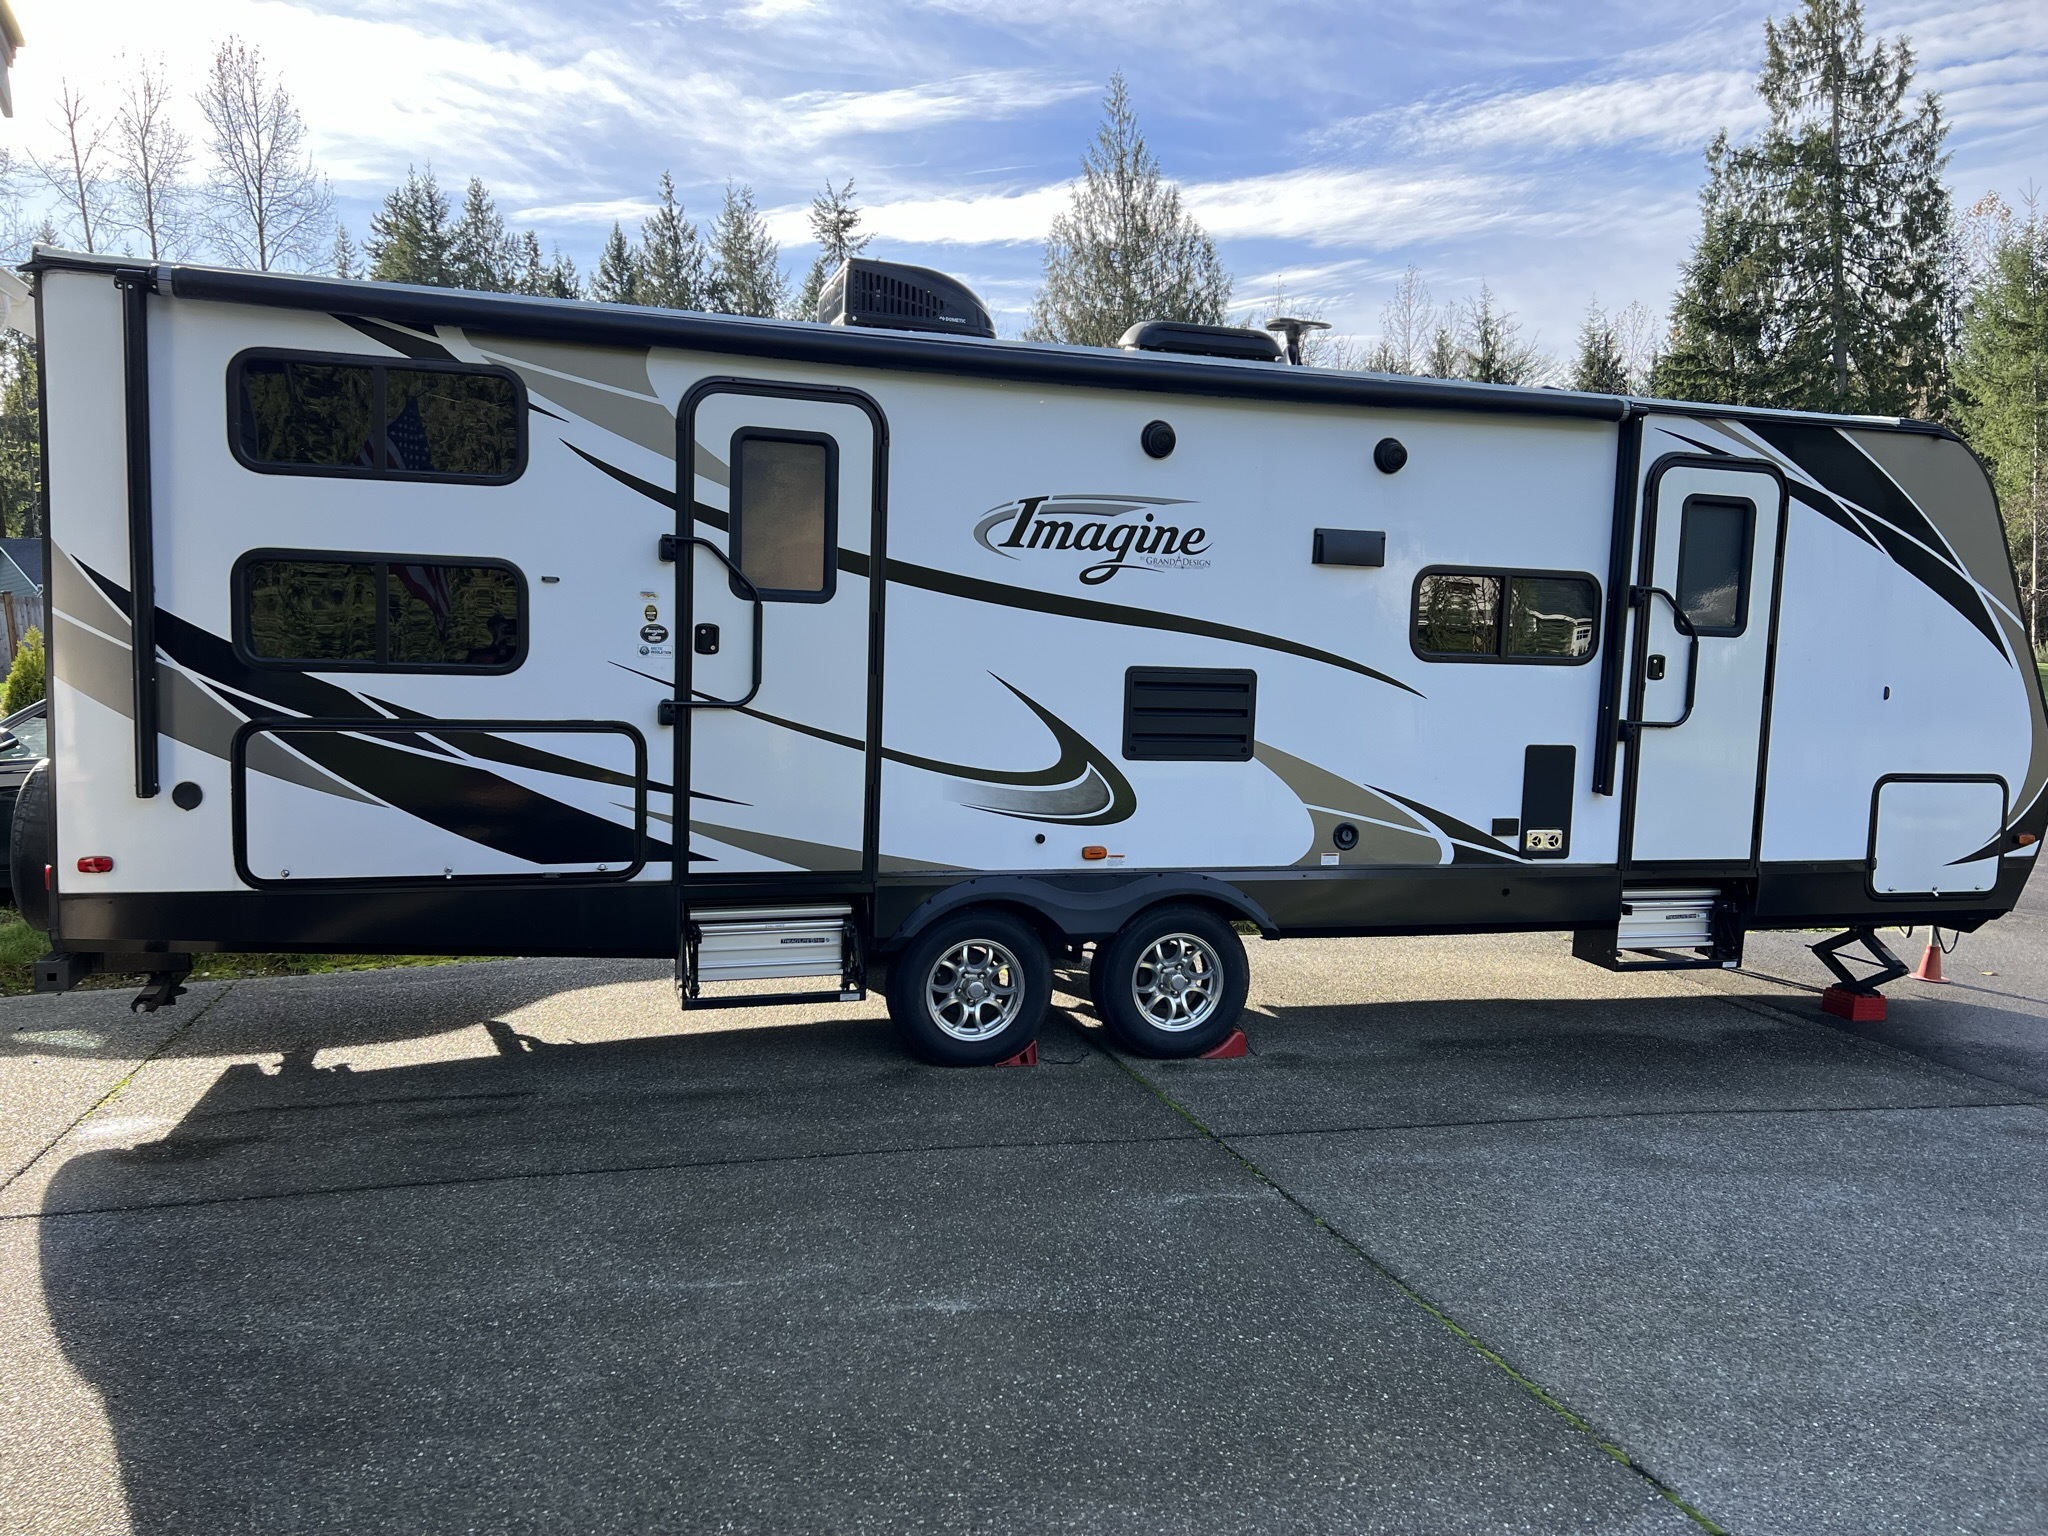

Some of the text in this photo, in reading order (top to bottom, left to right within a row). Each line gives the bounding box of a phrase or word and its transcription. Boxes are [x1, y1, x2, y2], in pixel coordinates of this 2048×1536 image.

[997, 495, 1213, 585] Imagine
[1145, 556, 1176, 566] GRAND
[1182, 557, 1211, 567] DESIGN
